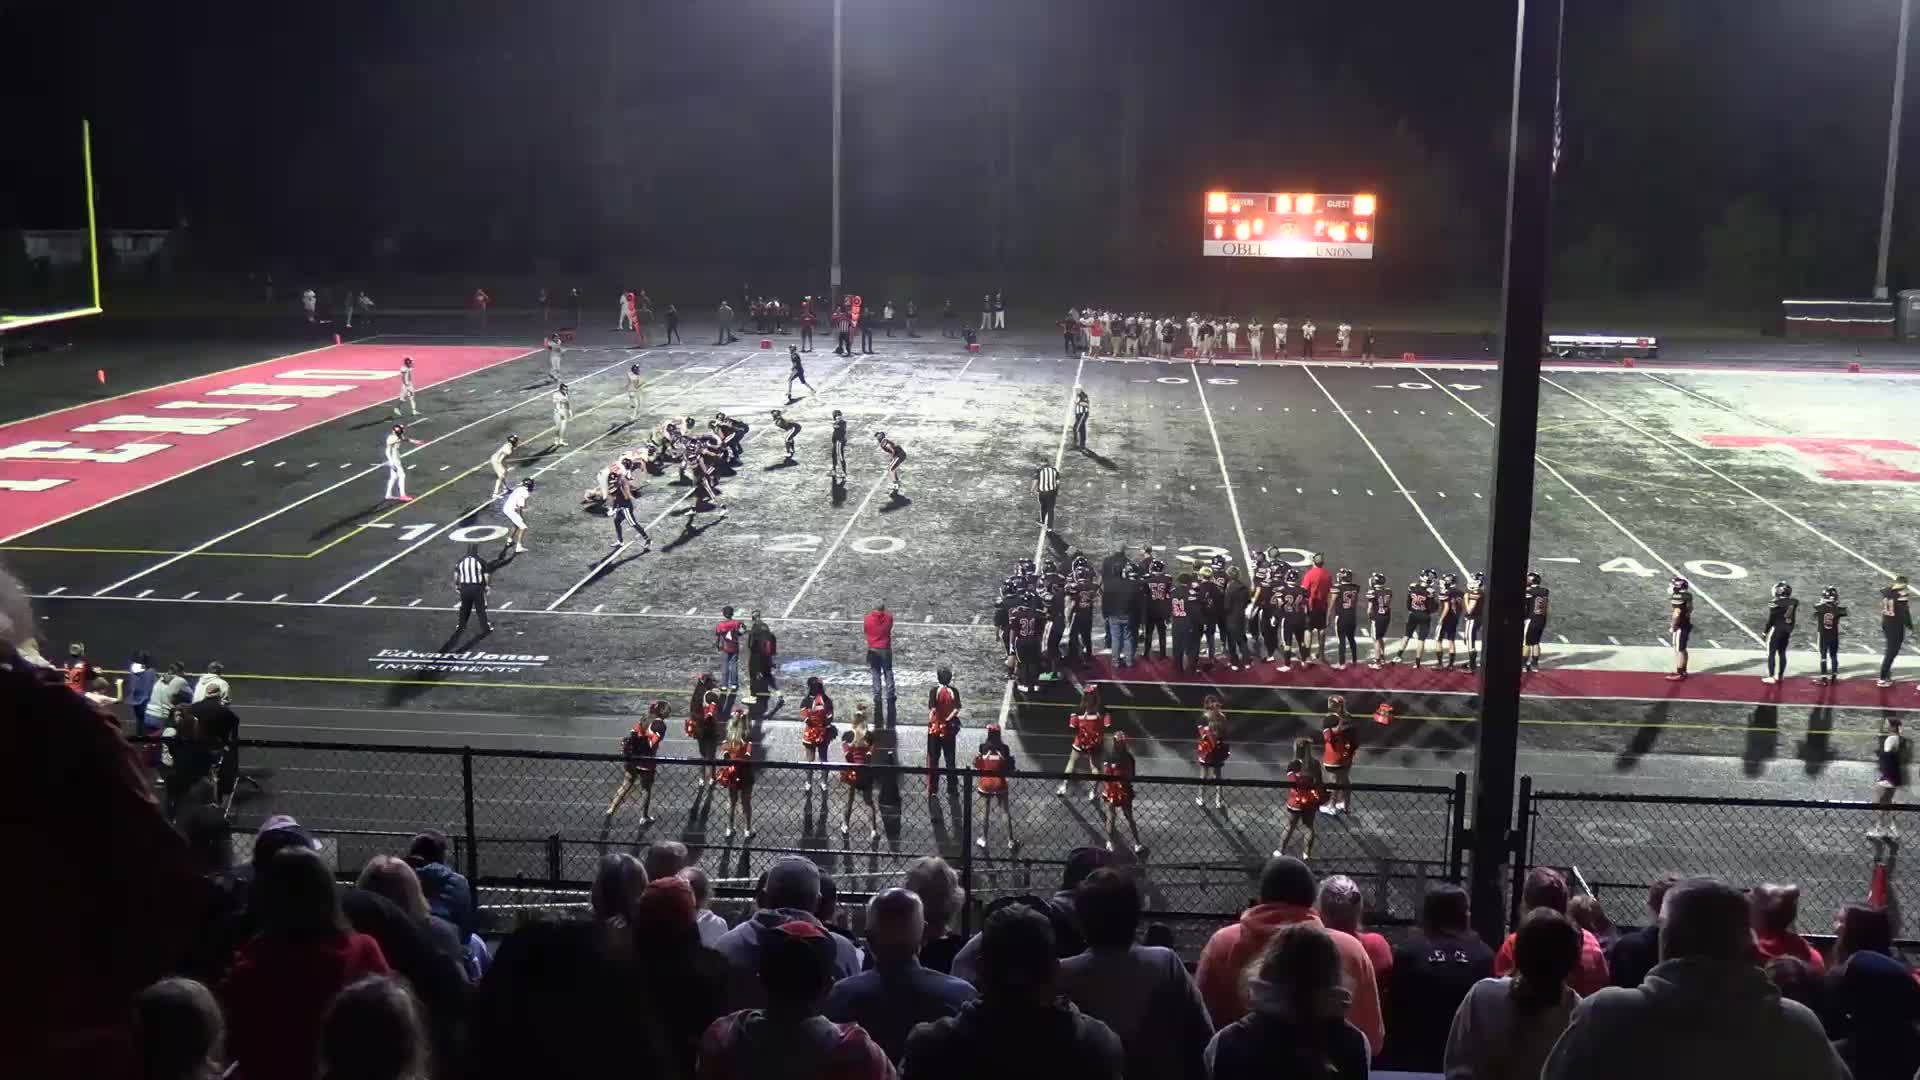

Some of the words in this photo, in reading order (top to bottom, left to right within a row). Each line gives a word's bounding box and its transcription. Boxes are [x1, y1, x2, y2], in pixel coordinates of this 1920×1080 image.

[1327, 200, 1351, 208] GUEST
[0, 370, 402, 491] ENINO
[398, 523, 509, 542] 10
[764, 534, 907, 554] 20
[1175, 545, 1319, 566] 30
[1598, 556, 1749, 579] 40
[375, 663, 522, 673] INVESTMENTS
